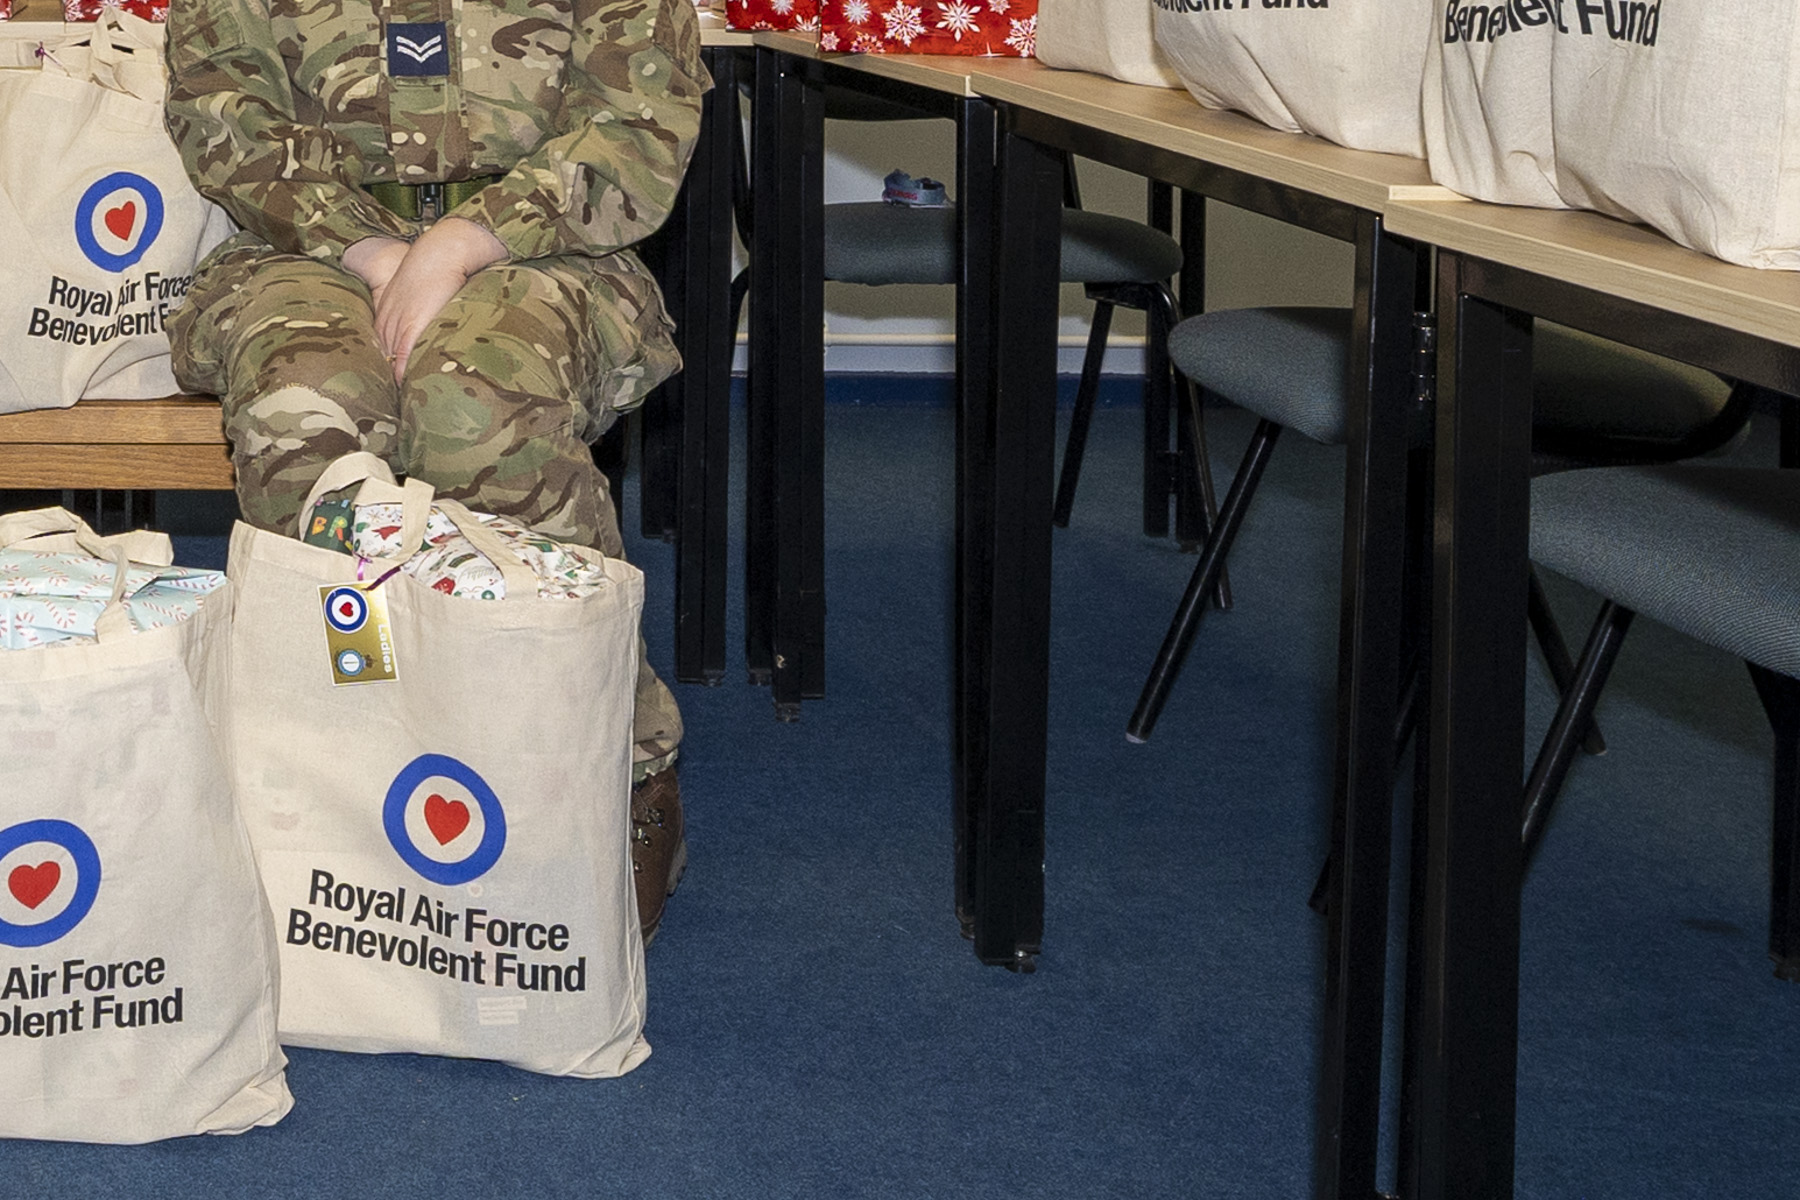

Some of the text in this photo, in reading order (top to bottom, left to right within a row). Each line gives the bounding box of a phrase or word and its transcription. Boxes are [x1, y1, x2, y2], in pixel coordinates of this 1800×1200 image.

[48, 275, 114, 318] Royal
[114, 278, 141, 315] Air
[144, 271, 192, 301] Force
[27, 305, 159, 347] Benevolent
[377, 623, 394, 674] Ladies
[308, 868, 570, 953] Royal Air Force
[286, 907, 587, 993] Benevolent Fund
[0, 963, 58, 1001] Air
[62, 956, 167, 996] Force
[91, 986, 185, 1030] Fund
